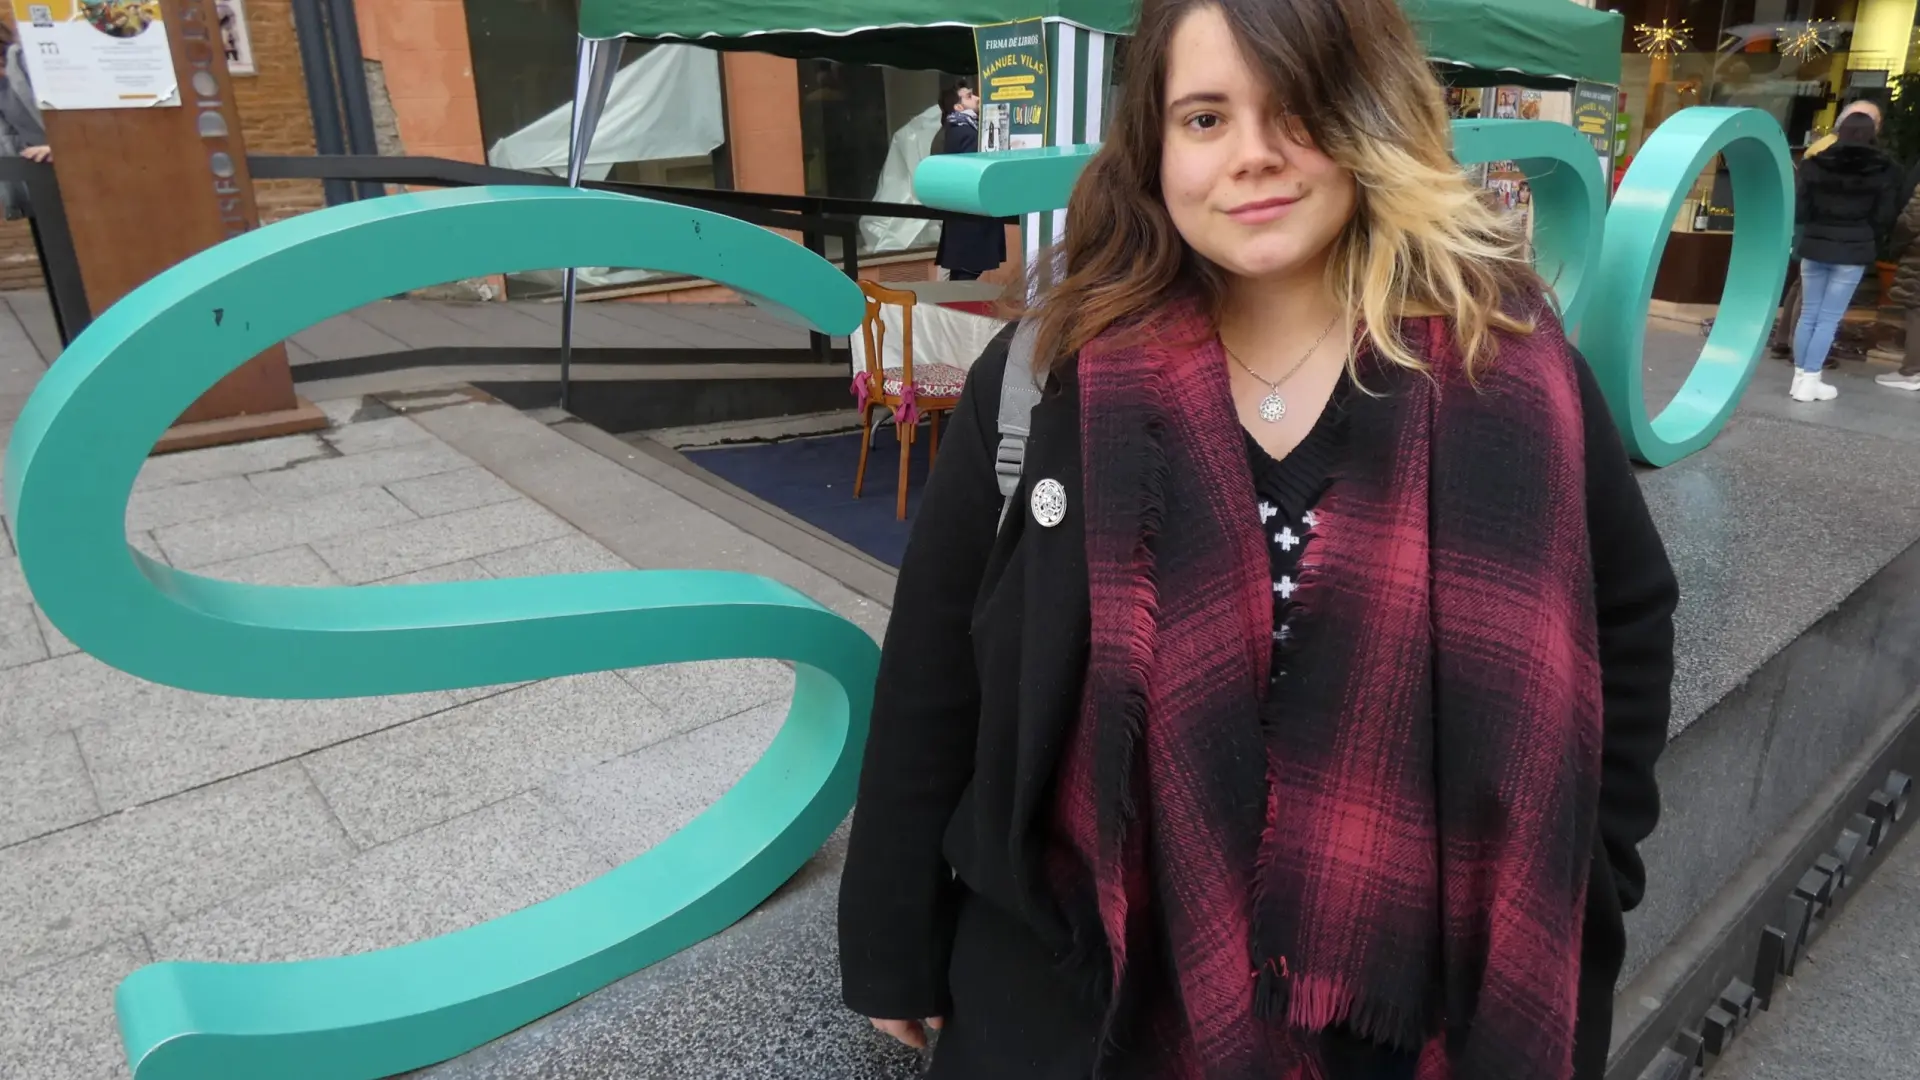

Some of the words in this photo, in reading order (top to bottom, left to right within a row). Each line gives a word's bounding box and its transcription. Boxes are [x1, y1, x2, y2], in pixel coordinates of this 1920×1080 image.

[985, 38, 1008, 50] FIRMA
[1008, 37, 1018, 47] DE
[1018, 34, 1039, 46] LIBROS
[982, 54, 1018, 78] MANUEL
[1021, 54, 1044, 74] VILAS
